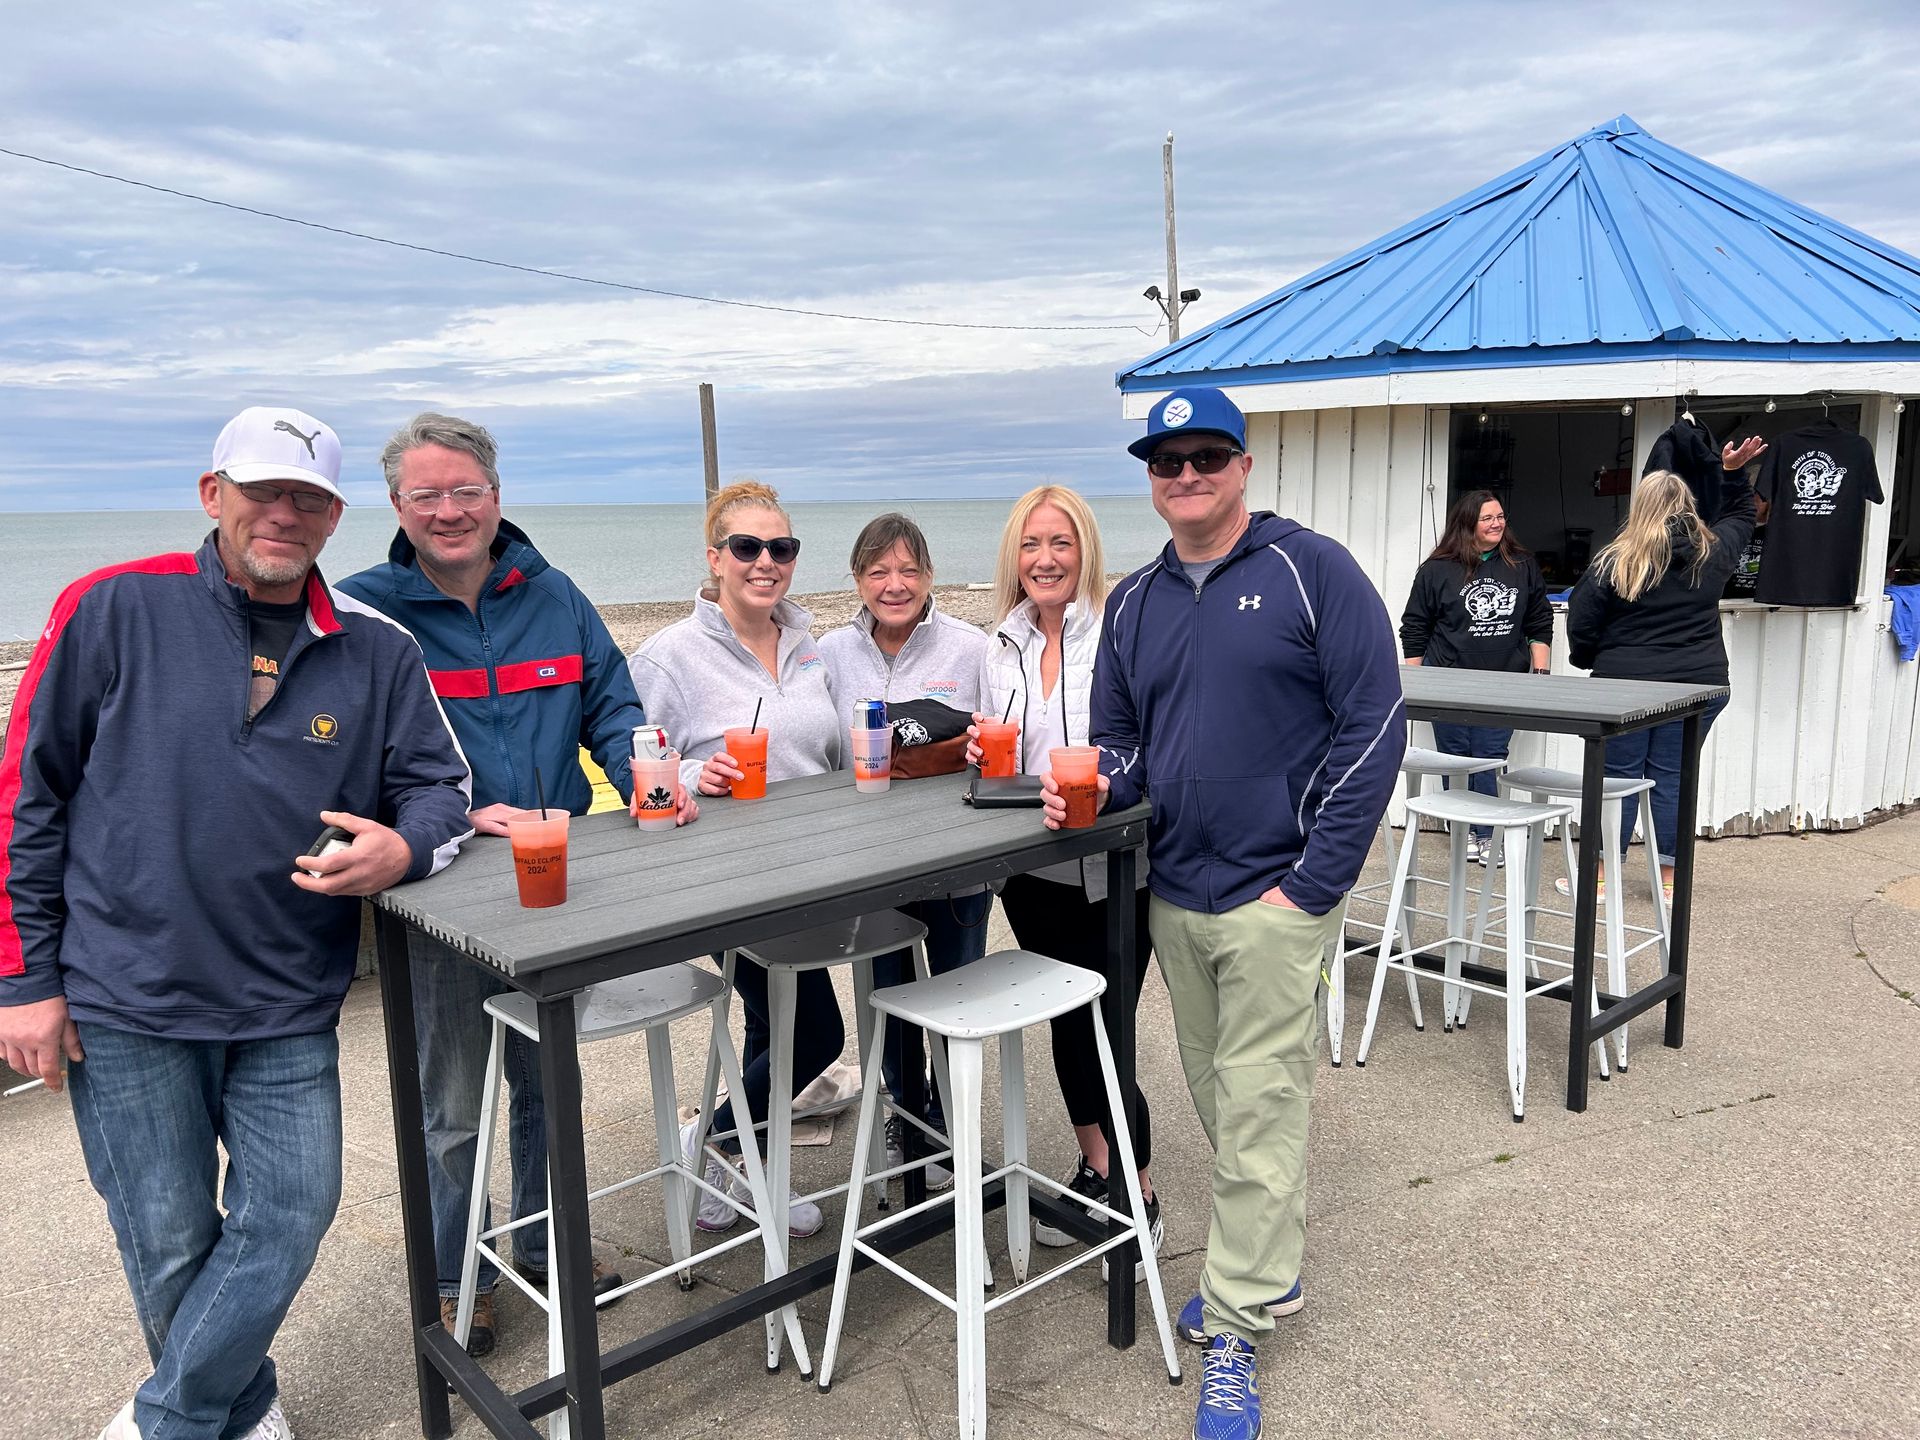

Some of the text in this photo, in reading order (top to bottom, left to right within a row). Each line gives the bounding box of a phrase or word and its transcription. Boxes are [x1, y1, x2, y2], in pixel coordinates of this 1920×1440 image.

[252, 655, 279, 675] NA
[639, 799, 675, 811] Labatt
[537, 854, 562, 865] ECLIPSE
[527, 865, 547, 875] 2024
